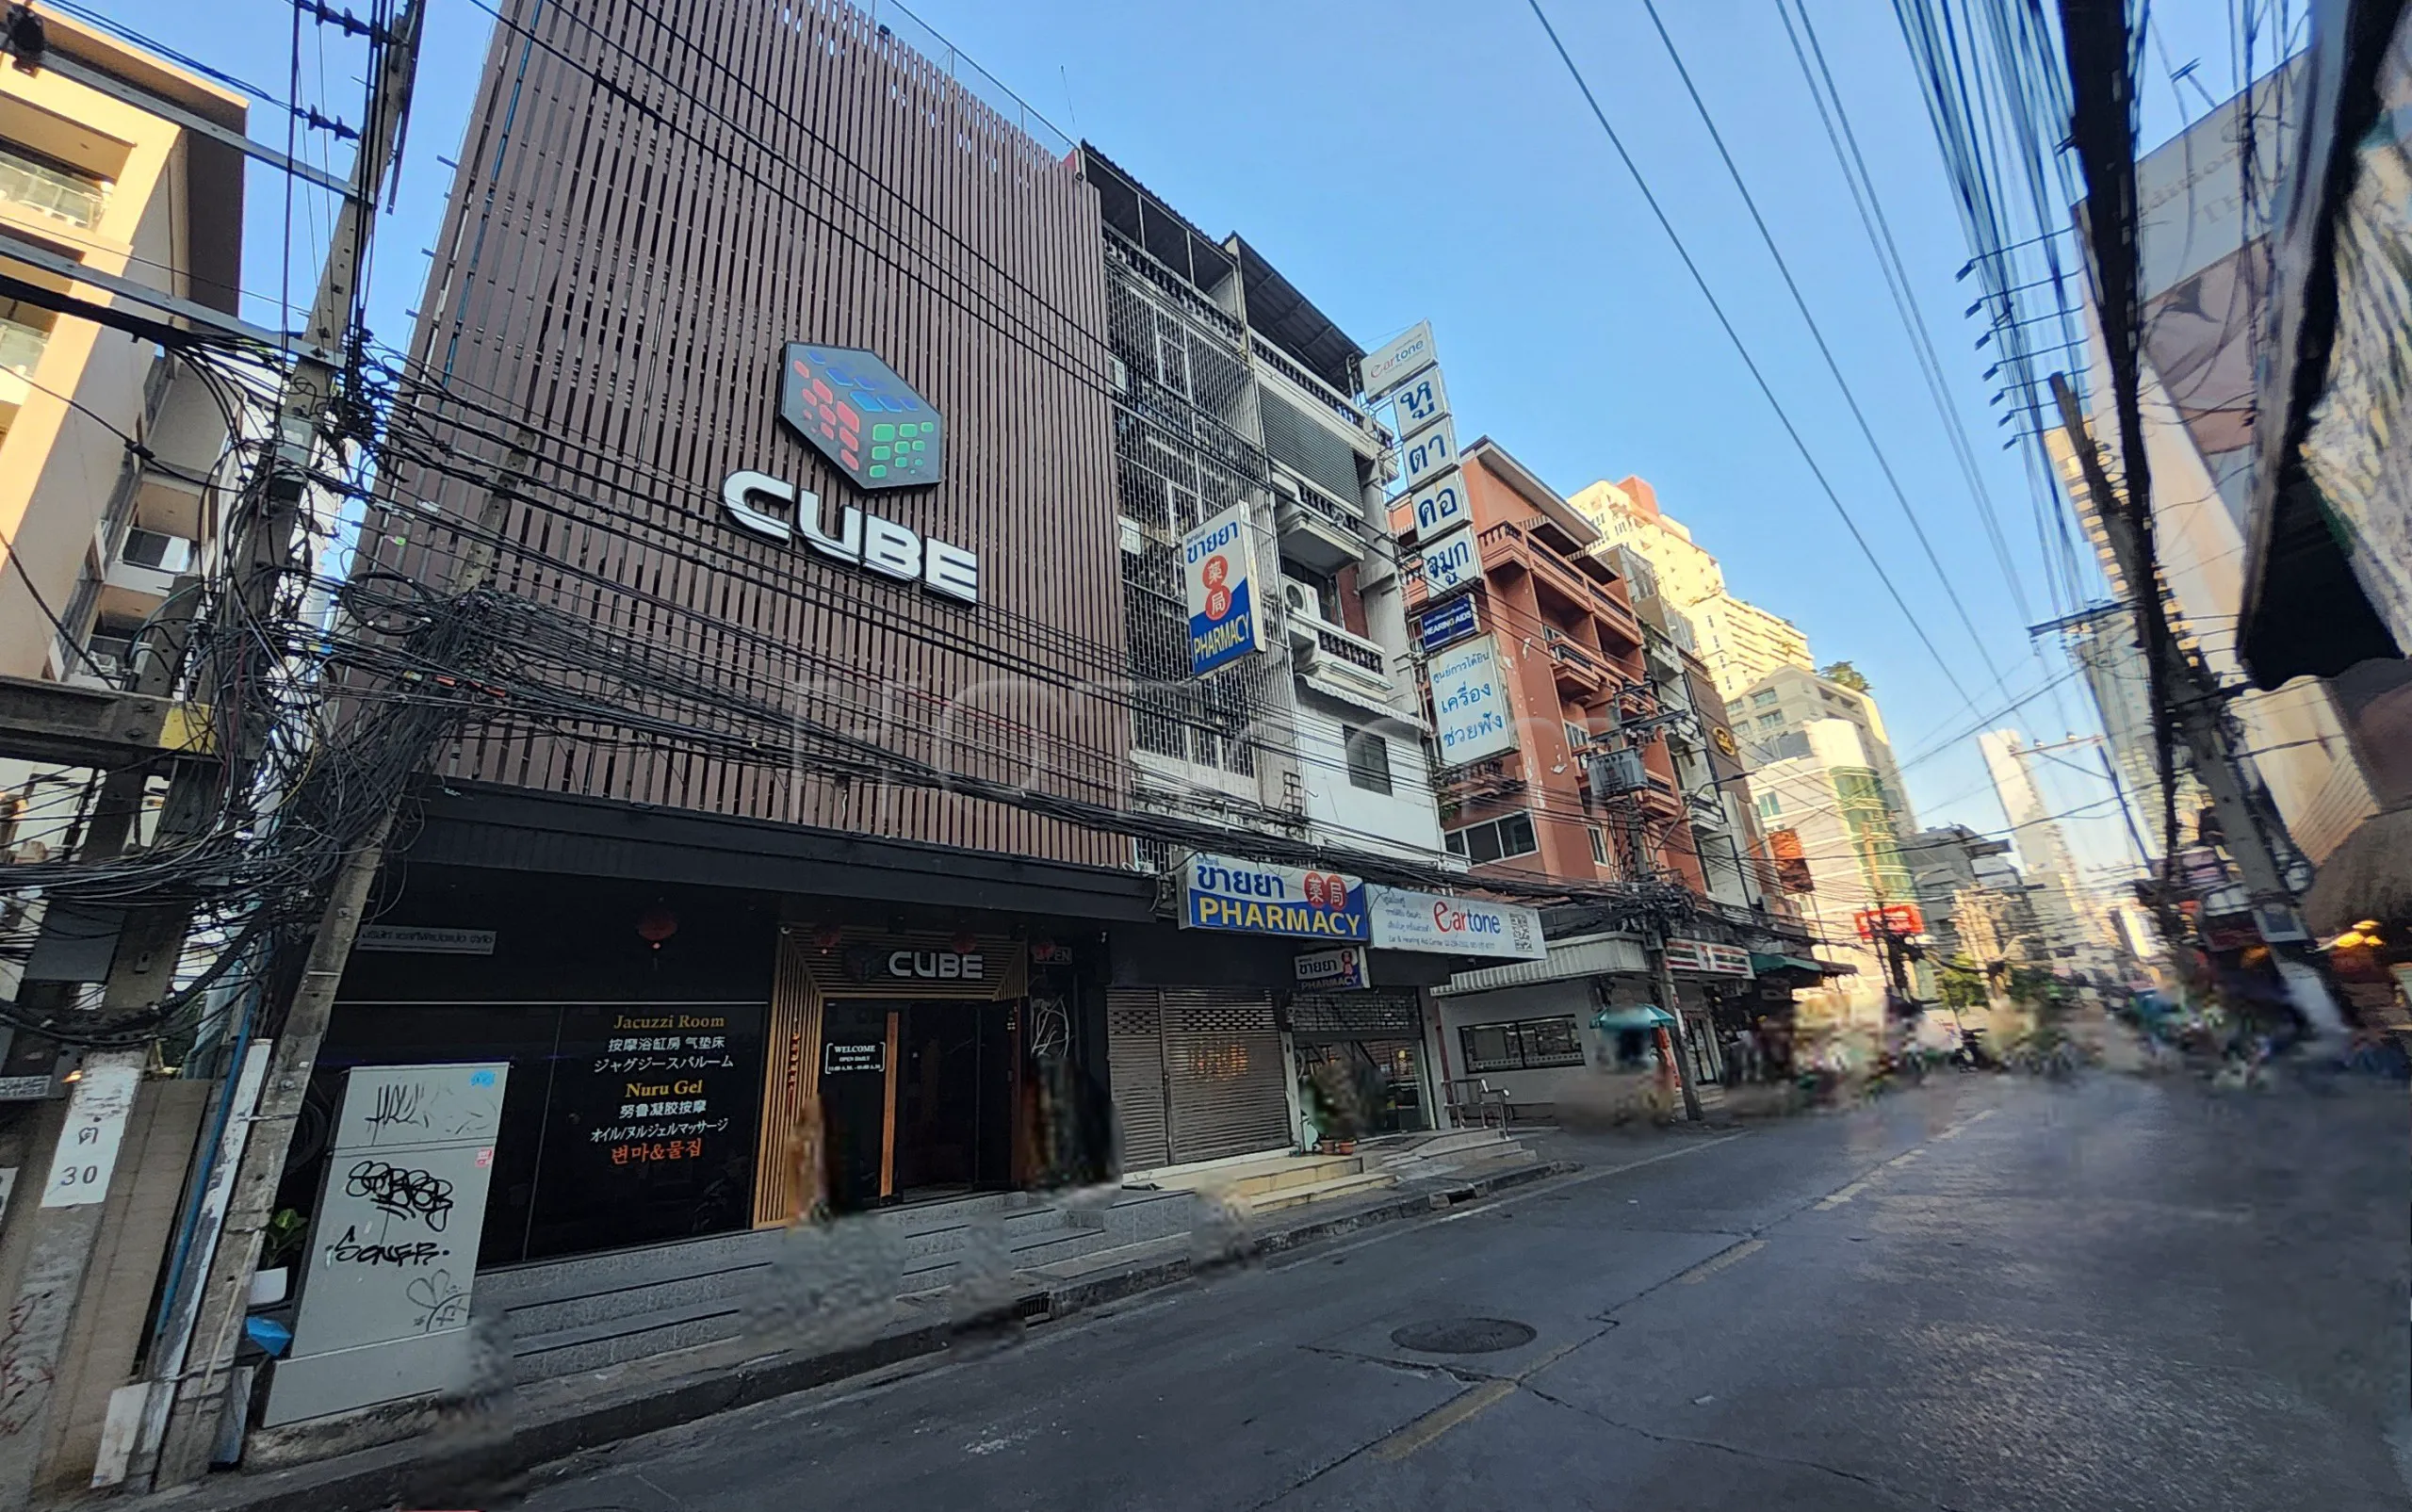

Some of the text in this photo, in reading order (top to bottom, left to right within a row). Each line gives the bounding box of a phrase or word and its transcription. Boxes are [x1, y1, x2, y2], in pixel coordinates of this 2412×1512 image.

[1371, 340, 1424, 379] eartone
[1400, 381, 1435, 419] หู
[1410, 433, 1446, 475] ตา
[1418, 487, 1458, 528] คอ
[722, 469, 978, 605] CUBE
[1187, 521, 1239, 563] ขายยา
[1426, 541, 1470, 586] จมูก
[1194, 611, 1250, 664] PHARMACY
[1424, 617, 1455, 637] HEARING
[1456, 610, 1472, 624] AIDS
[1442, 681, 1491, 714] เครื่อง
[1443, 711, 1504, 748] ช่วยฟัง
[1196, 865, 1285, 899] ขายยา
[1198, 896, 1361, 936] PHARMACY
[1433, 901, 1502, 935] eartone
[888, 951, 983, 979] CUBE
[1300, 959, 1338, 974] ขายยา
[1301, 975, 1358, 991] PHARMACY
[613, 1015, 725, 1029] Jacuzzi Room
[685, 1036, 726, 1050] 气垫床
[834, 1045, 876, 1053] WELCOME
[594, 1054, 734, 1073] ジャグジースパルーム
[625, 1080, 703, 1097] Nuru Gel
[611, 1137, 703, 1165] 변마&물집
[60, 1165, 98, 1187] 30
